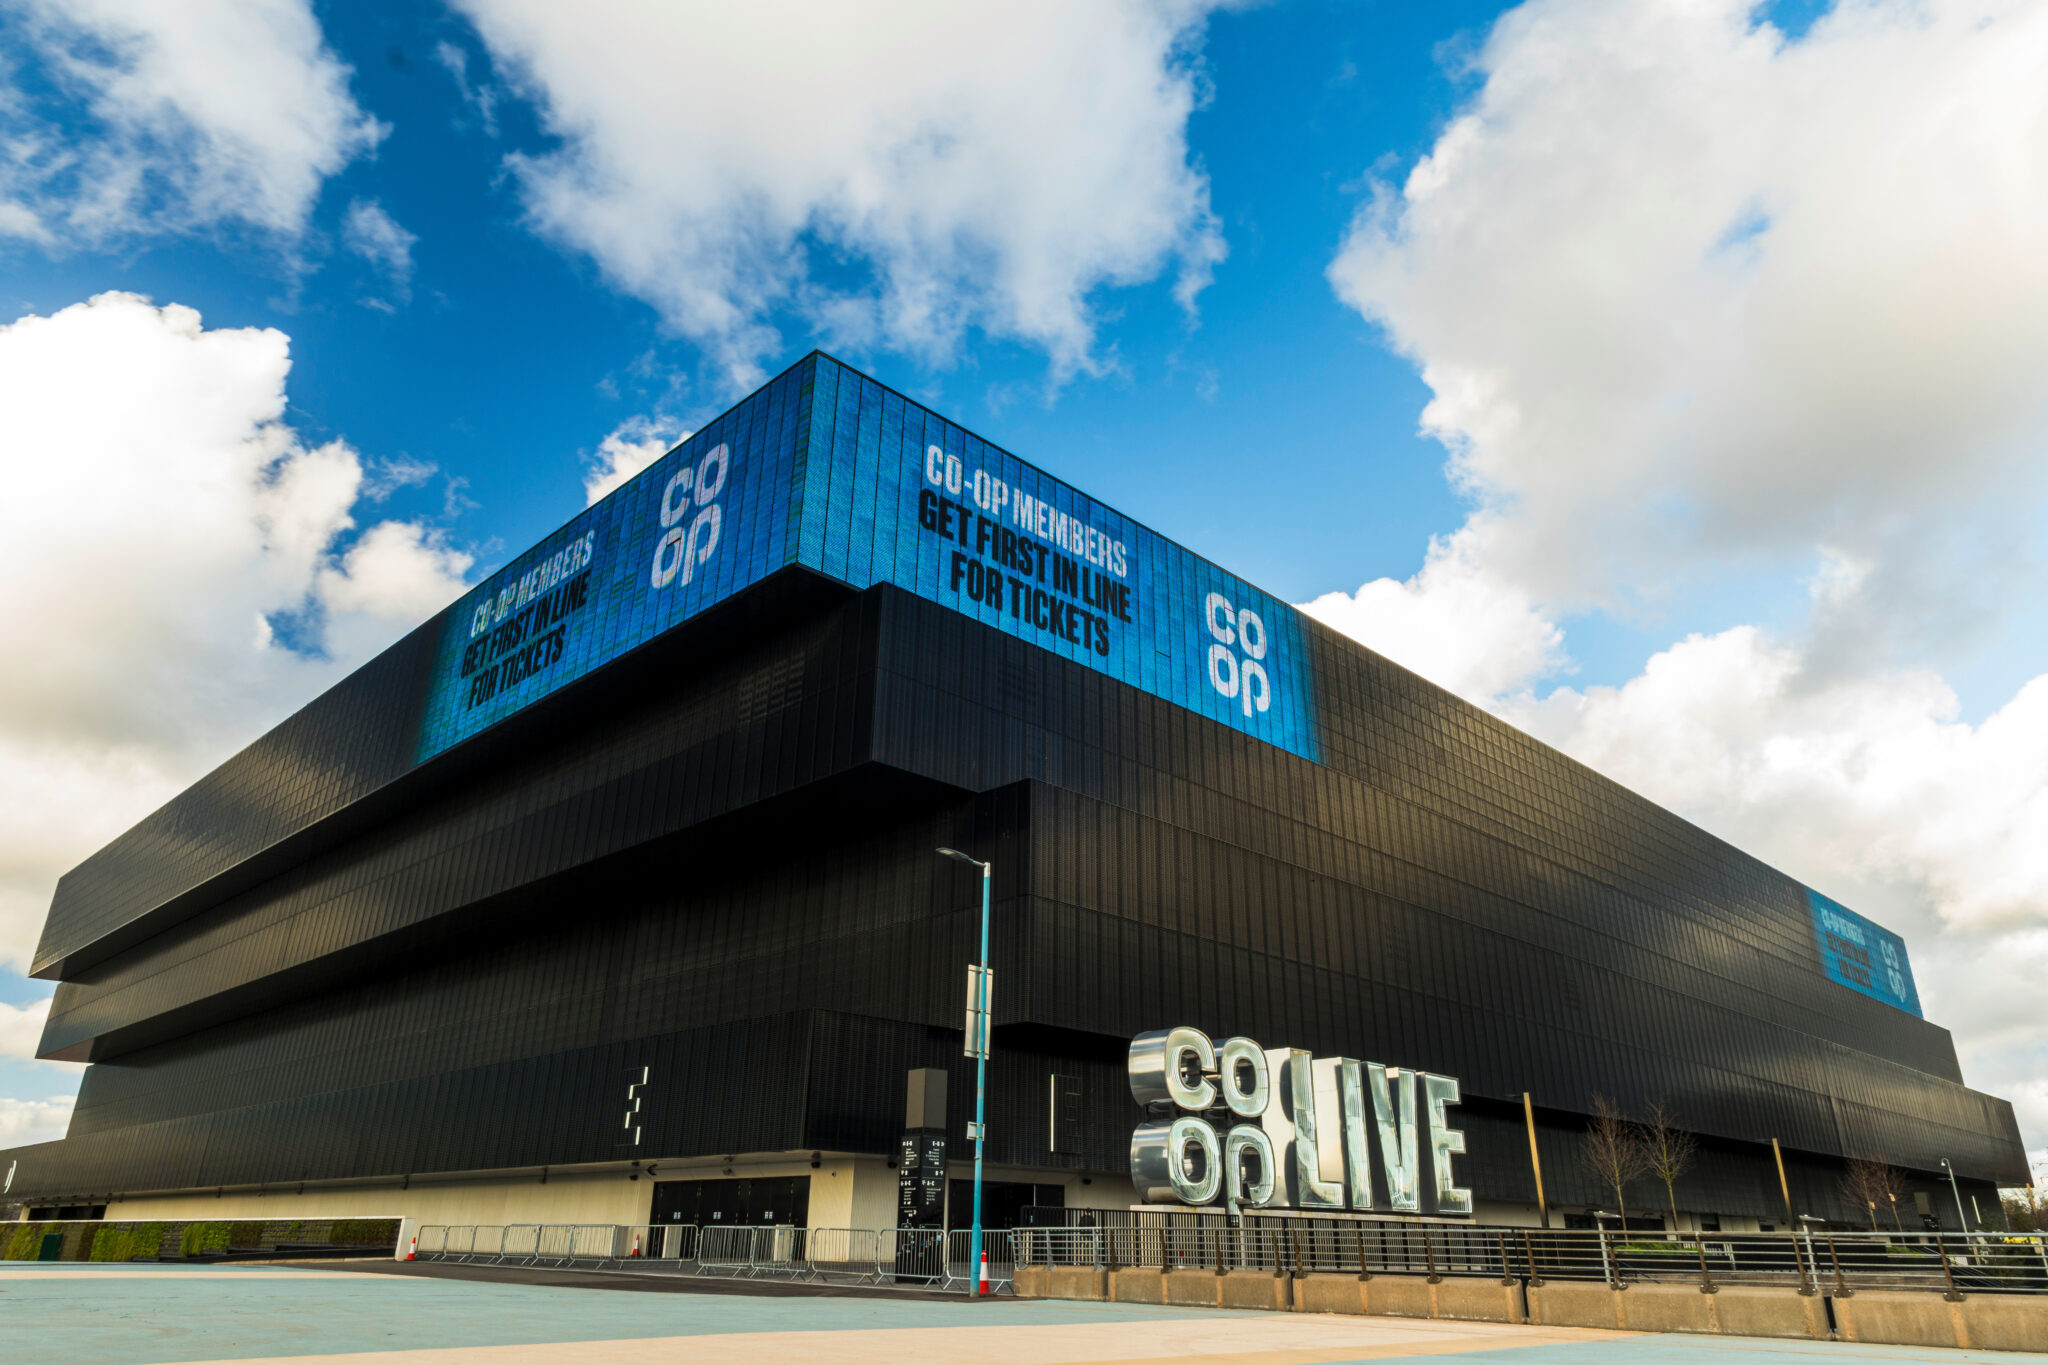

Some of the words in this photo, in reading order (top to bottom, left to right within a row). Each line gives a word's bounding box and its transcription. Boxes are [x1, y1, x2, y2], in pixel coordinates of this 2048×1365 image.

[919, 488, 973, 548] GET
[977, 514, 1050, 583] FIRST
[1053, 550, 1078, 599] IN
[1082, 565, 1132, 624] LINE
[927, 444, 1009, 516] CO-OP
[1013, 487, 1128, 578] MEMBERS
[461, 634, 491, 679] GET
[489, 604, 536, 662] FIRST
[532, 590, 553, 637] IN
[551, 569, 592, 625] LINE
[470, 582, 518, 638] CO-OP
[515, 529, 596, 610] MEMBERS
[950, 550, 1004, 612] FOR
[1008, 575, 1110, 657] TICKETS
[467, 665, 500, 712] FOR
[500, 624, 566, 694] TICKETS
[1286, 1047, 1474, 1214] LIVE
